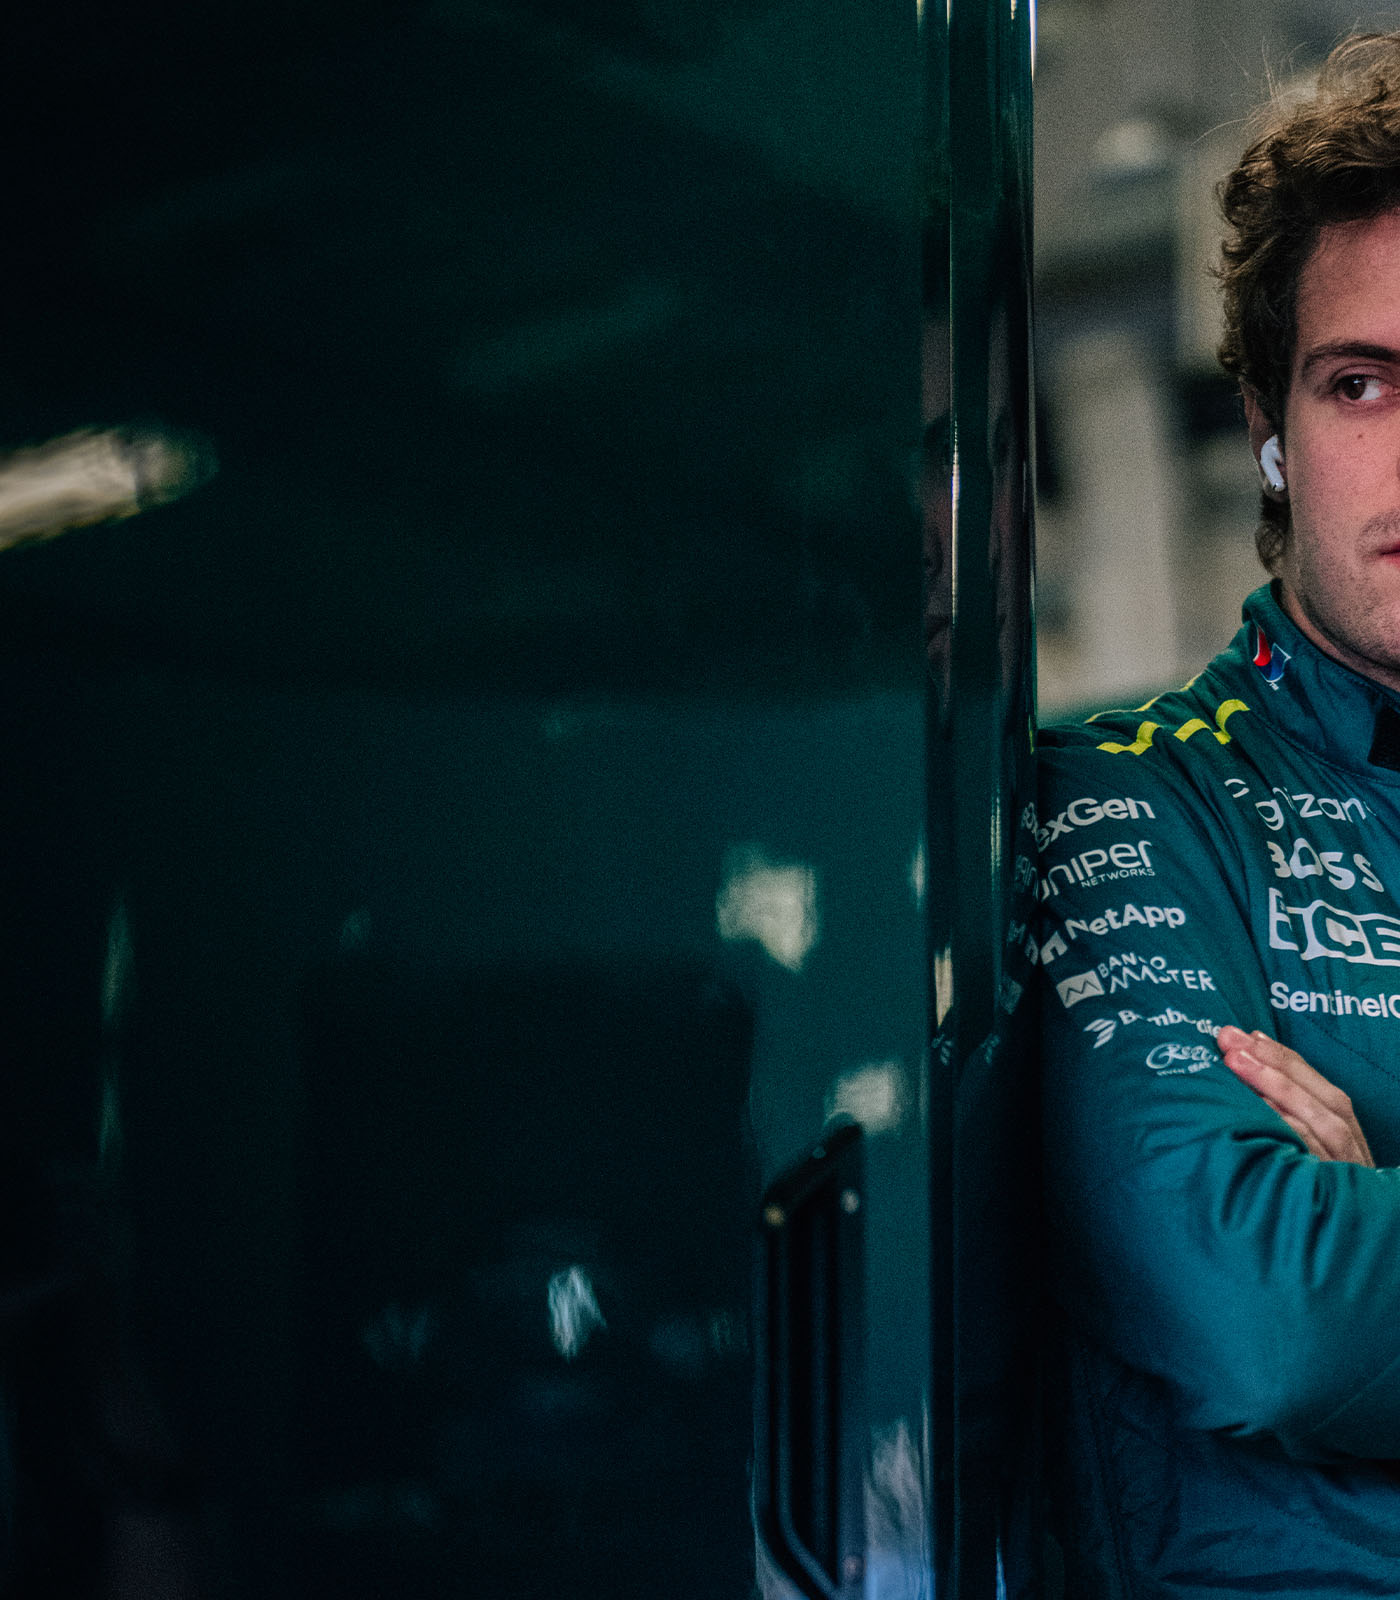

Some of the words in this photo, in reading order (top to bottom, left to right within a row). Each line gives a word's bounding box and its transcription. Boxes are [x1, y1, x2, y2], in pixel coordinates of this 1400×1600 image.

[1035, 797, 1156, 853] exGen
[1081, 867, 1156, 888] NETWORKS
[1064, 903, 1187, 940] NetApp
[1098, 952, 1166, 978] BANO
[1110, 965, 1216, 994] MATER
